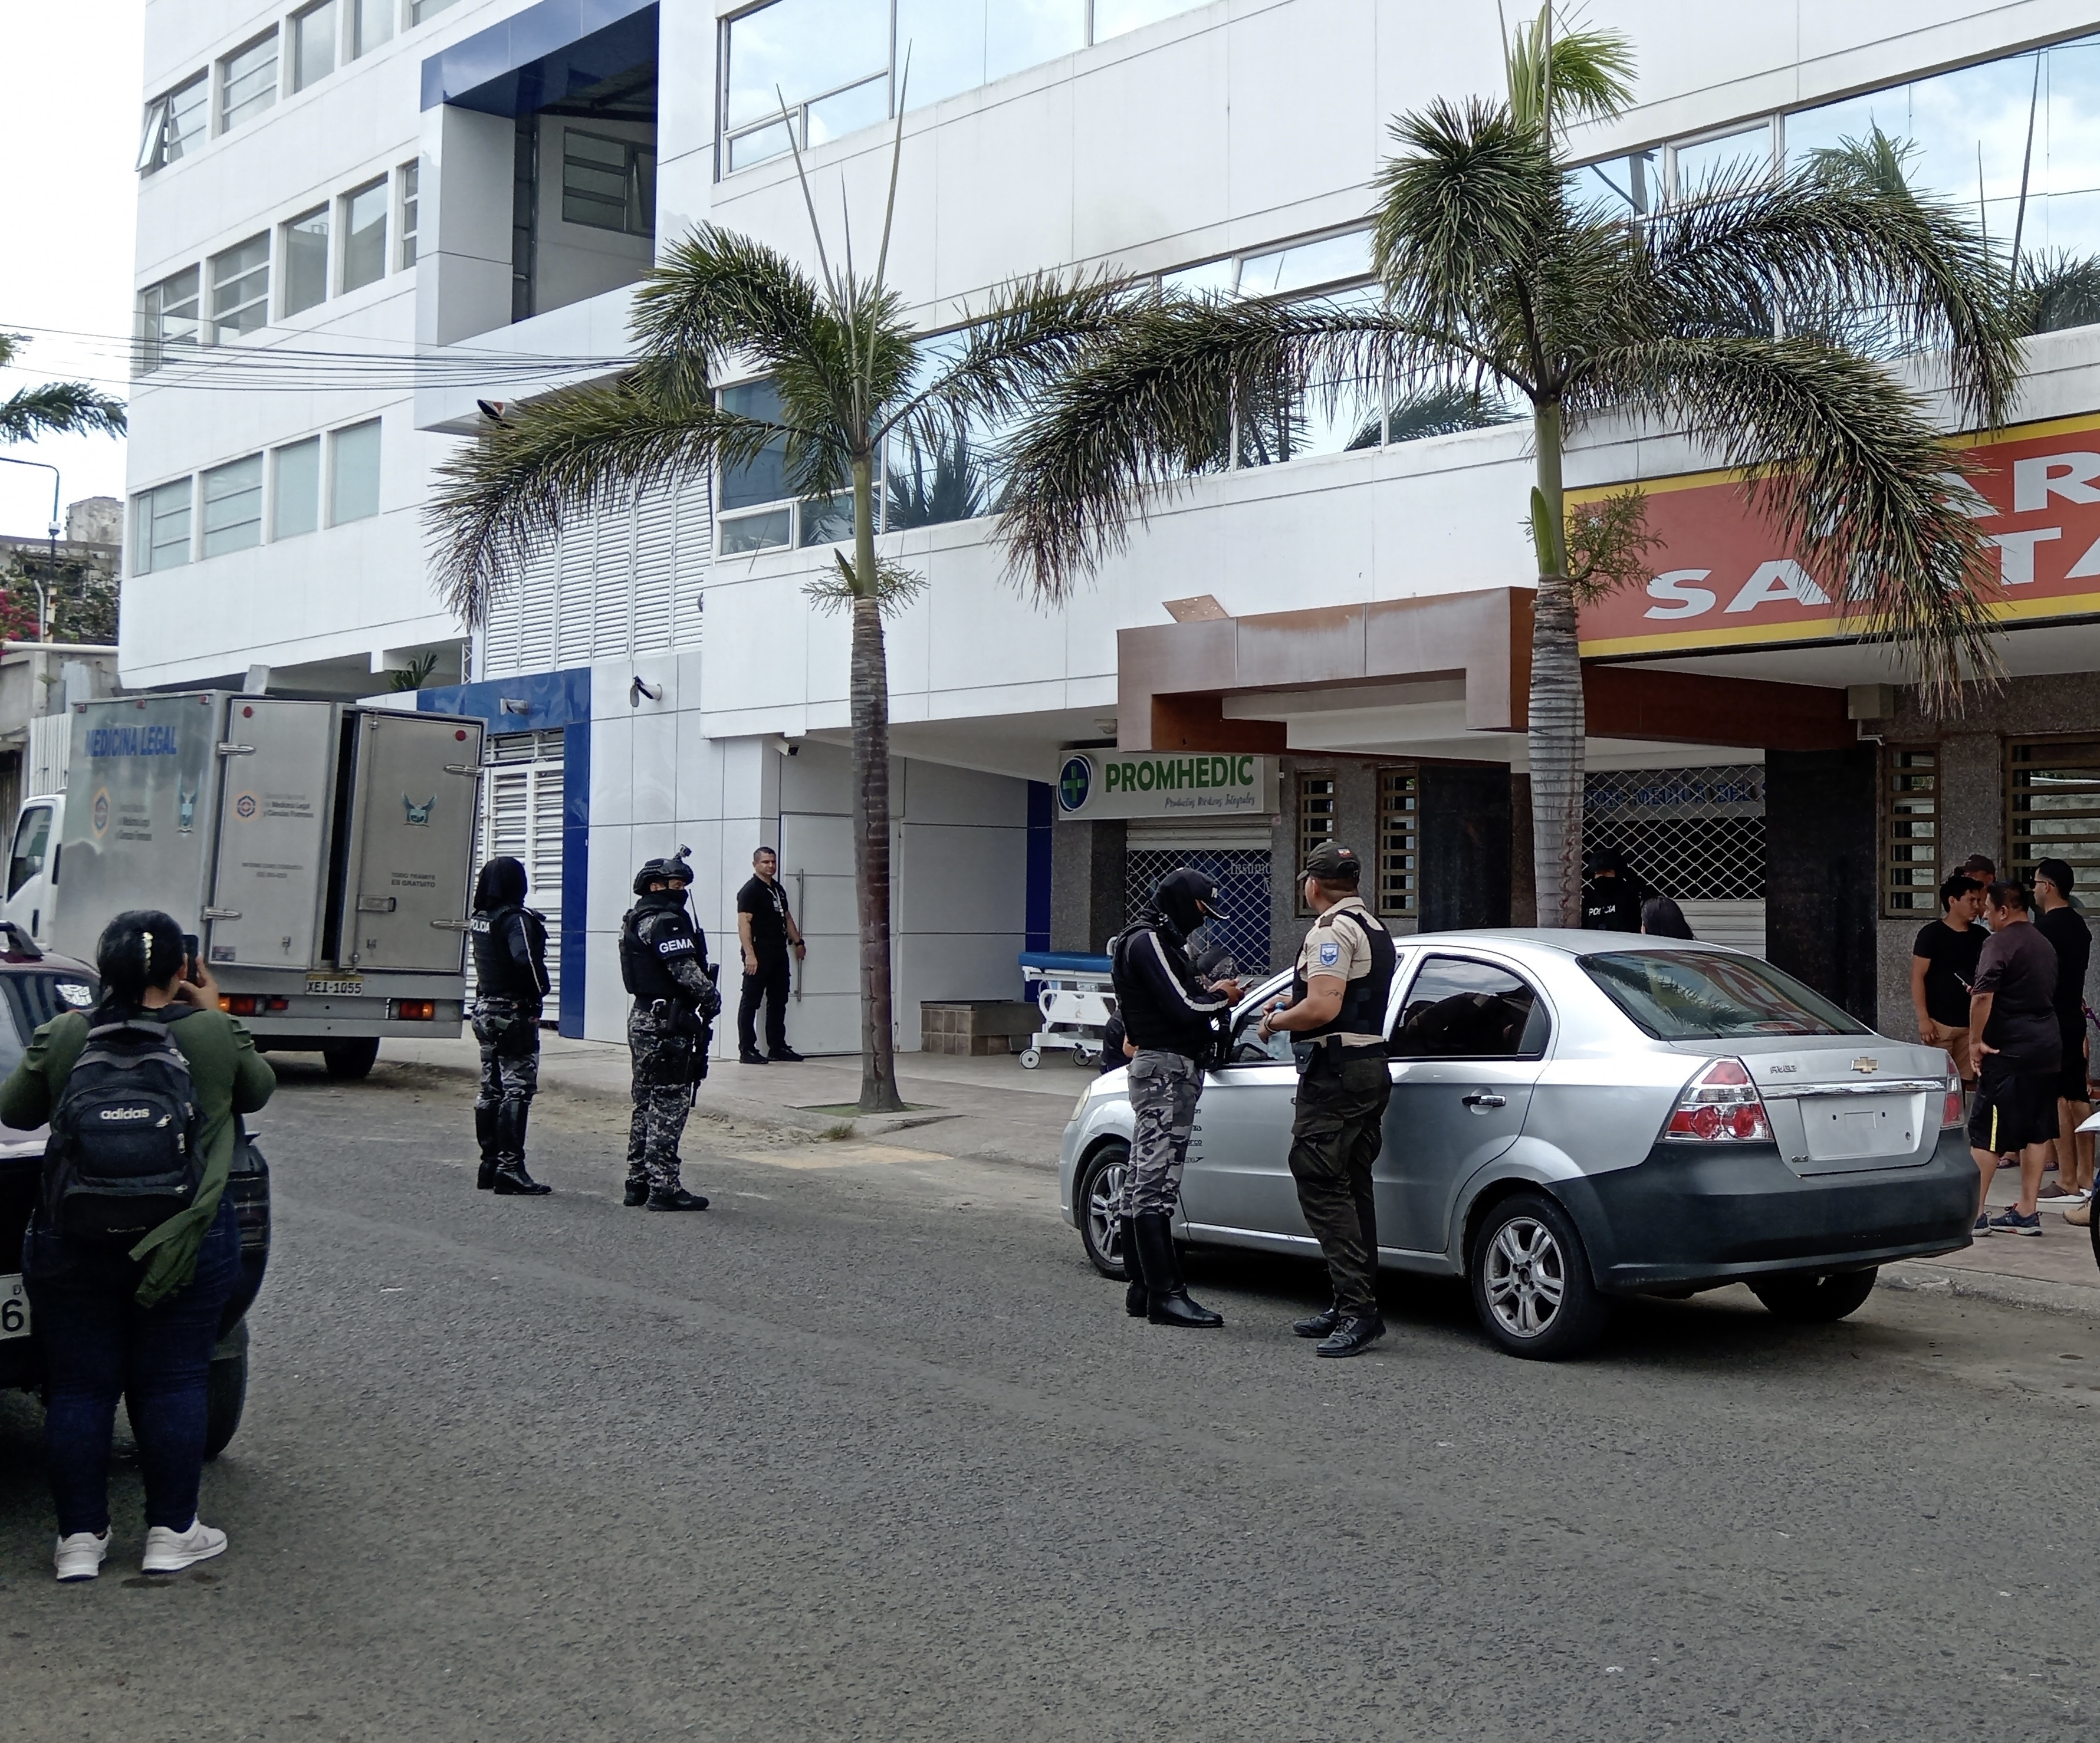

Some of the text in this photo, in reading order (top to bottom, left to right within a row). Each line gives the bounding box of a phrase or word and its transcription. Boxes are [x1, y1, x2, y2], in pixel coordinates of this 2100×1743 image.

[85, 726, 177, 757] MEDICINA LEGAL
[1105, 756, 1254, 792] PROMHEDIC
[659, 938, 695, 953] GEMA
[101, 1107, 150, 1120] adidas
